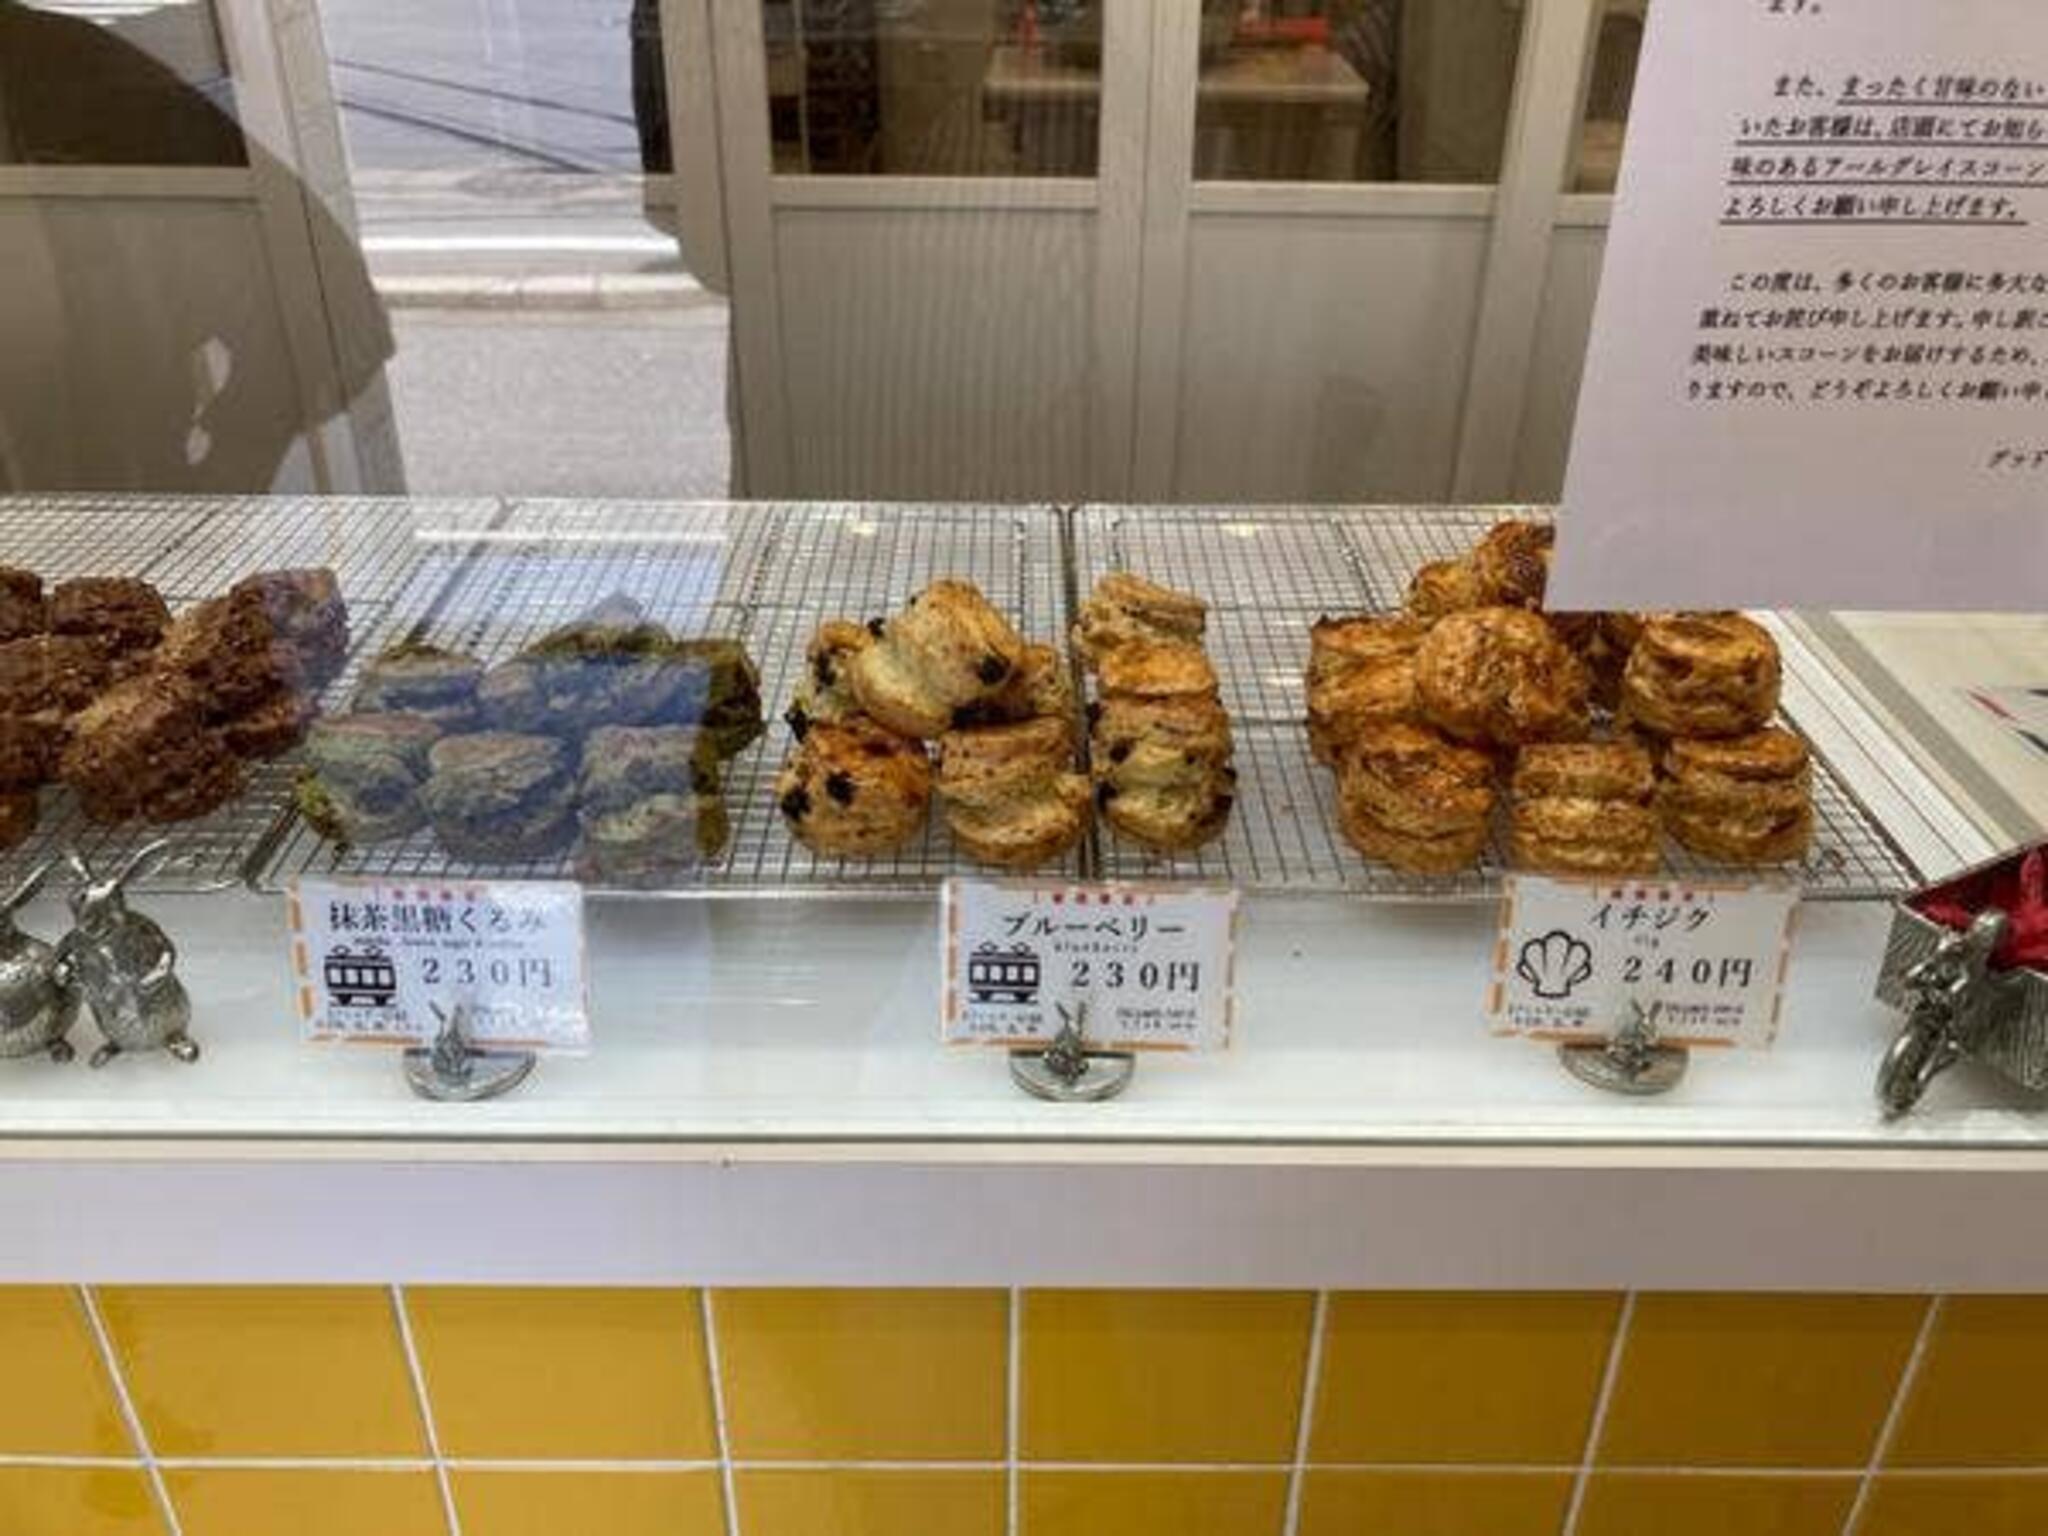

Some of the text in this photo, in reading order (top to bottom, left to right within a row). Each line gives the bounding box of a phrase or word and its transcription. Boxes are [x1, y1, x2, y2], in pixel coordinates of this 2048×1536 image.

[1730, 155, 2046, 178] 味のあるアールグレイスコーン
[1723, 193, 2018, 220] よろしくお願い申し上げます。
[1688, 379, 2048, 402] りますので、どうぞよろしくお願い申
[329, 901, 549, 934] 抹茶黒糖くるみ
[1003, 911, 1186, 942] ブルーベリー
[1590, 904, 1710, 931] イチジク
[421, 957, 552, 988] 230円
[1070, 960, 1200, 993] 230円
[1622, 955, 1753, 988] 240円
